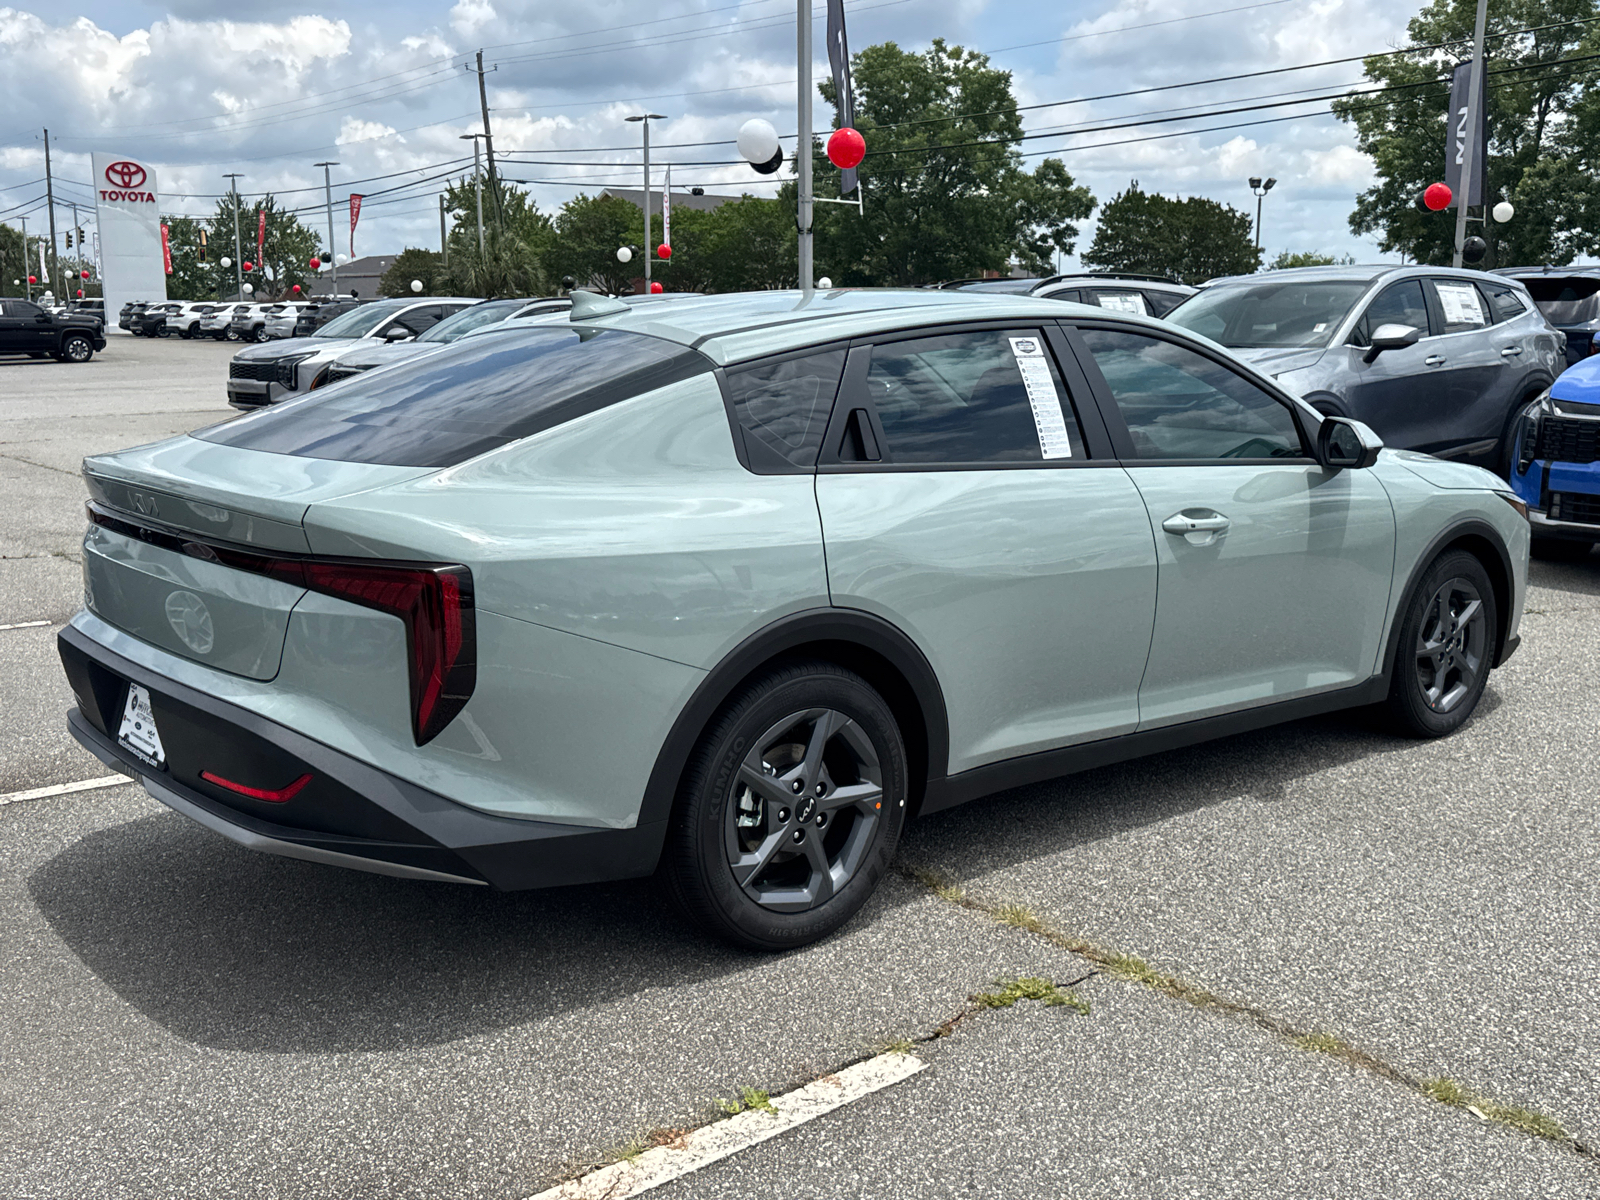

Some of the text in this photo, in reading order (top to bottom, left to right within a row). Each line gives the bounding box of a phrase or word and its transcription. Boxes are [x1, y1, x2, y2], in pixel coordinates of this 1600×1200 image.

[99, 190, 156, 203] TOYOTA
[708, 736, 746, 820] KUMHO
[768, 926, 790, 938] 91H
